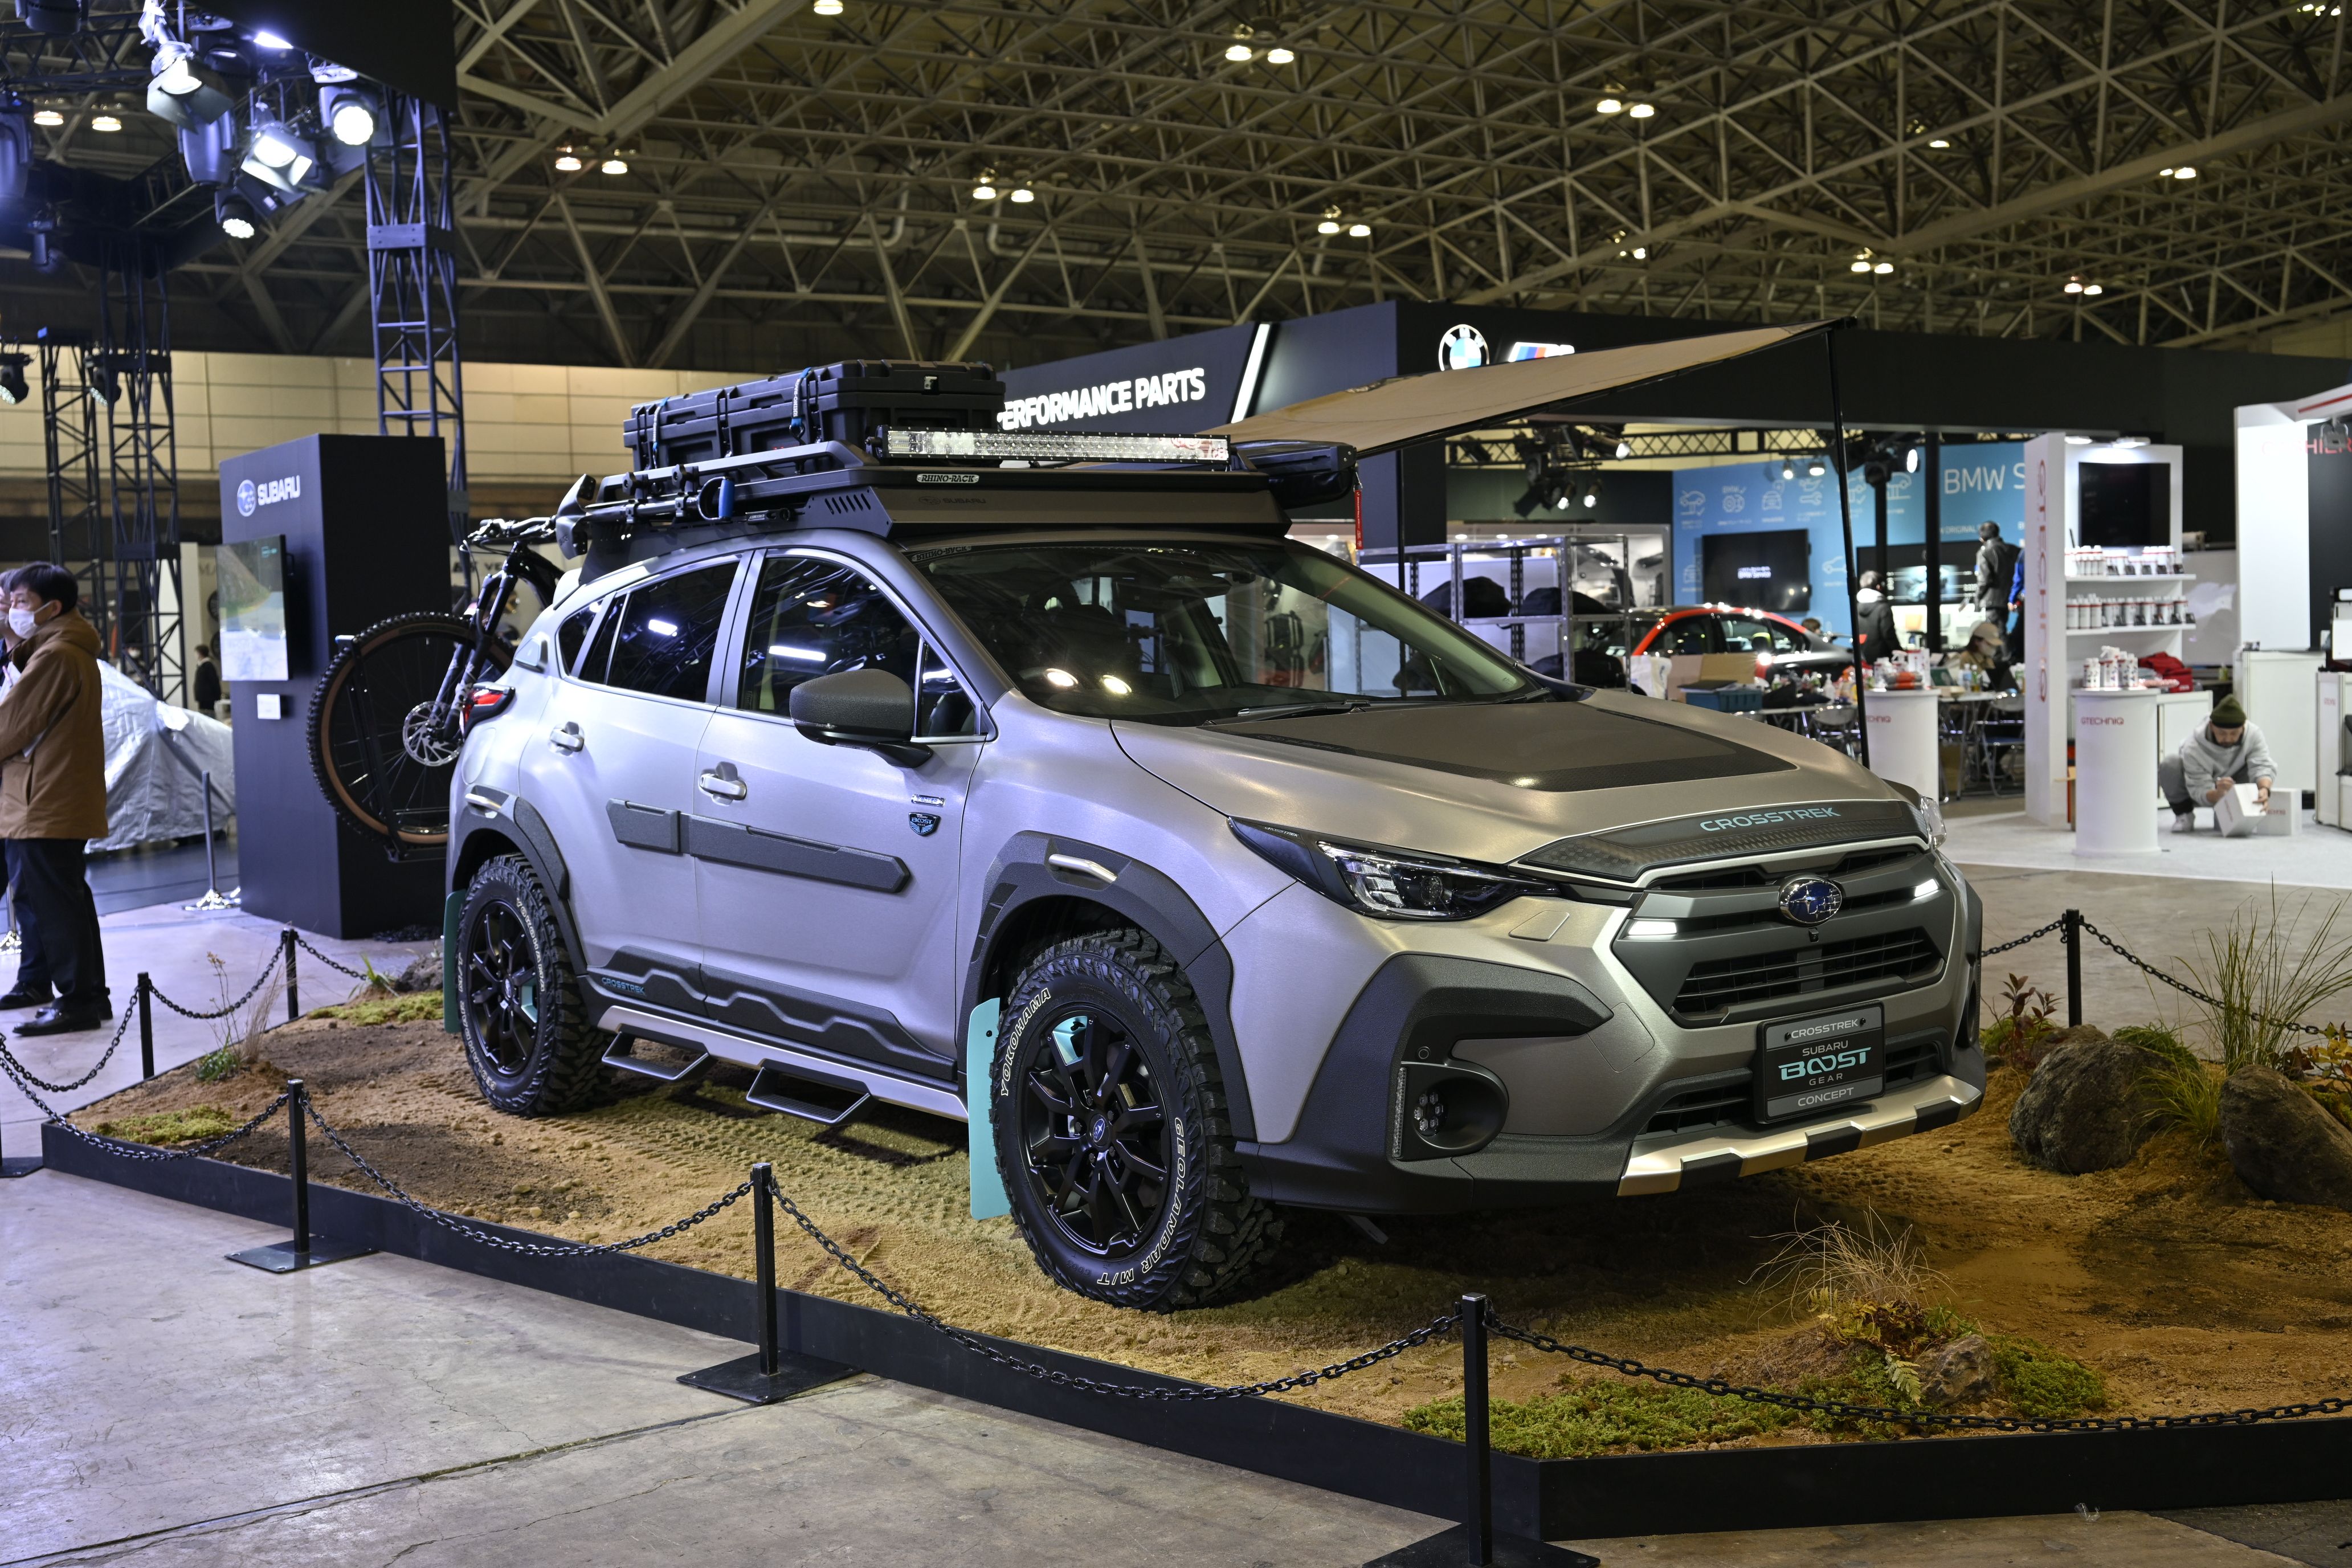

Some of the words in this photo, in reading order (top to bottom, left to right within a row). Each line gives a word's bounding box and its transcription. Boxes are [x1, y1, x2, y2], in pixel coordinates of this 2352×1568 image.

[1135, 368, 1205, 409] PARTS
[257, 475, 301, 506] SUBARU
[1944, 464, 2006, 494] BMW
[1700, 807, 1841, 831] CROSSTREK
[601, 977, 647, 996] CROSSTREK
[1791, 1018, 1859, 1039] CROSSTREK
[1001, 987, 1051, 1096] YOKOHAMA
[1802, 1040, 1848, 1056] SUBARU
[1778, 1047, 1872, 1081] BOOST
[1809, 1073, 1843, 1085] GEAR
[1798, 1087, 1854, 1106] CONCEPT
[1141, 1117, 1186, 1274] GEOLANDAR
[1097, 1268, 1134, 1285] M/T
